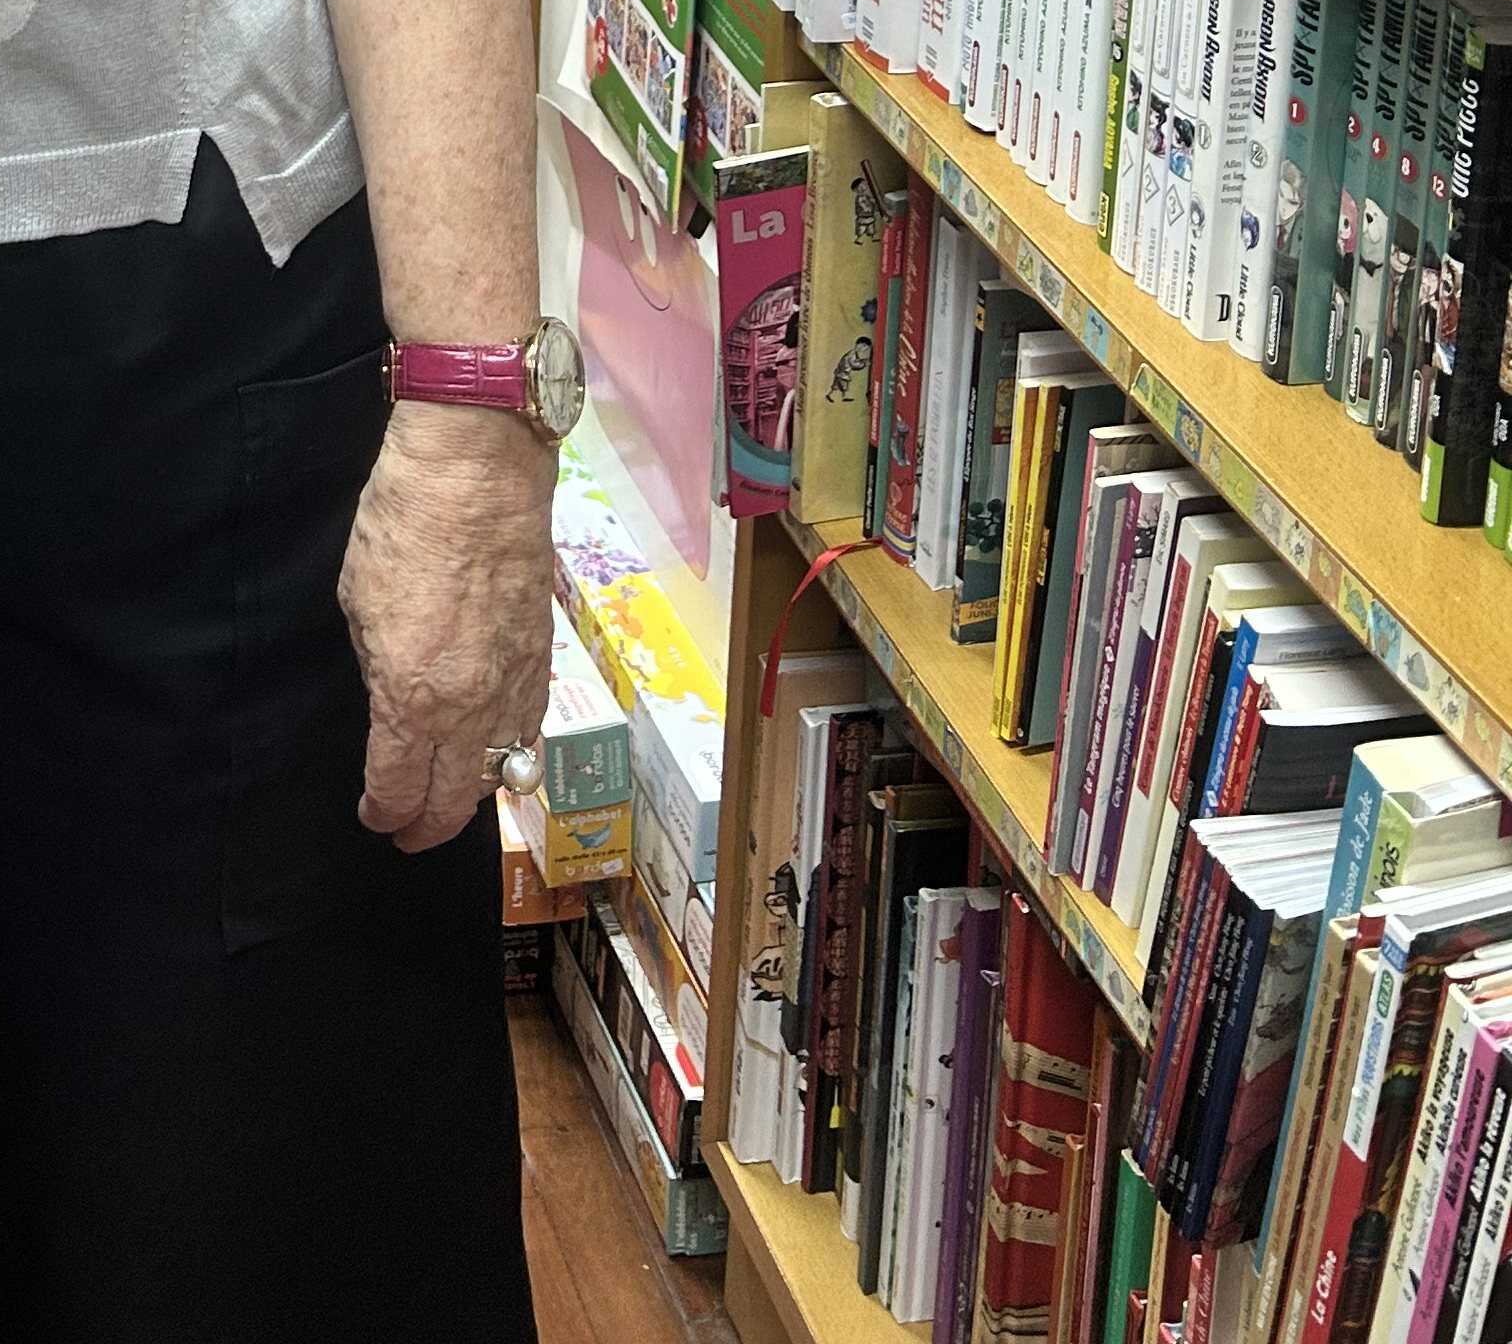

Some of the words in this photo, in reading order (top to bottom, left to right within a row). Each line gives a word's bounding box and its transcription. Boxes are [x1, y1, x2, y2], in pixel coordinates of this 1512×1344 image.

[1291, 102, 1298, 118] 1
[1348, 116, 1355, 133] 2
[1372, 137, 1380, 154] 4
[1401, 158, 1411, 175] 8
[1432, 176, 1444, 197] 12
[731, 208, 787, 245] La
[1358, 791, 1375, 840] Jade
[1353, 838, 1365, 860] de
[1416, 1119, 1435, 1164] Akiko
[1444, 1160, 1465, 1209] Akiko
[1471, 1158, 1491, 1204] Akiko
[1485, 1199, 1505, 1244] Akiko
[1316, 1249, 1337, 1299] Chine
[1311, 1299, 1327, 1326] La
